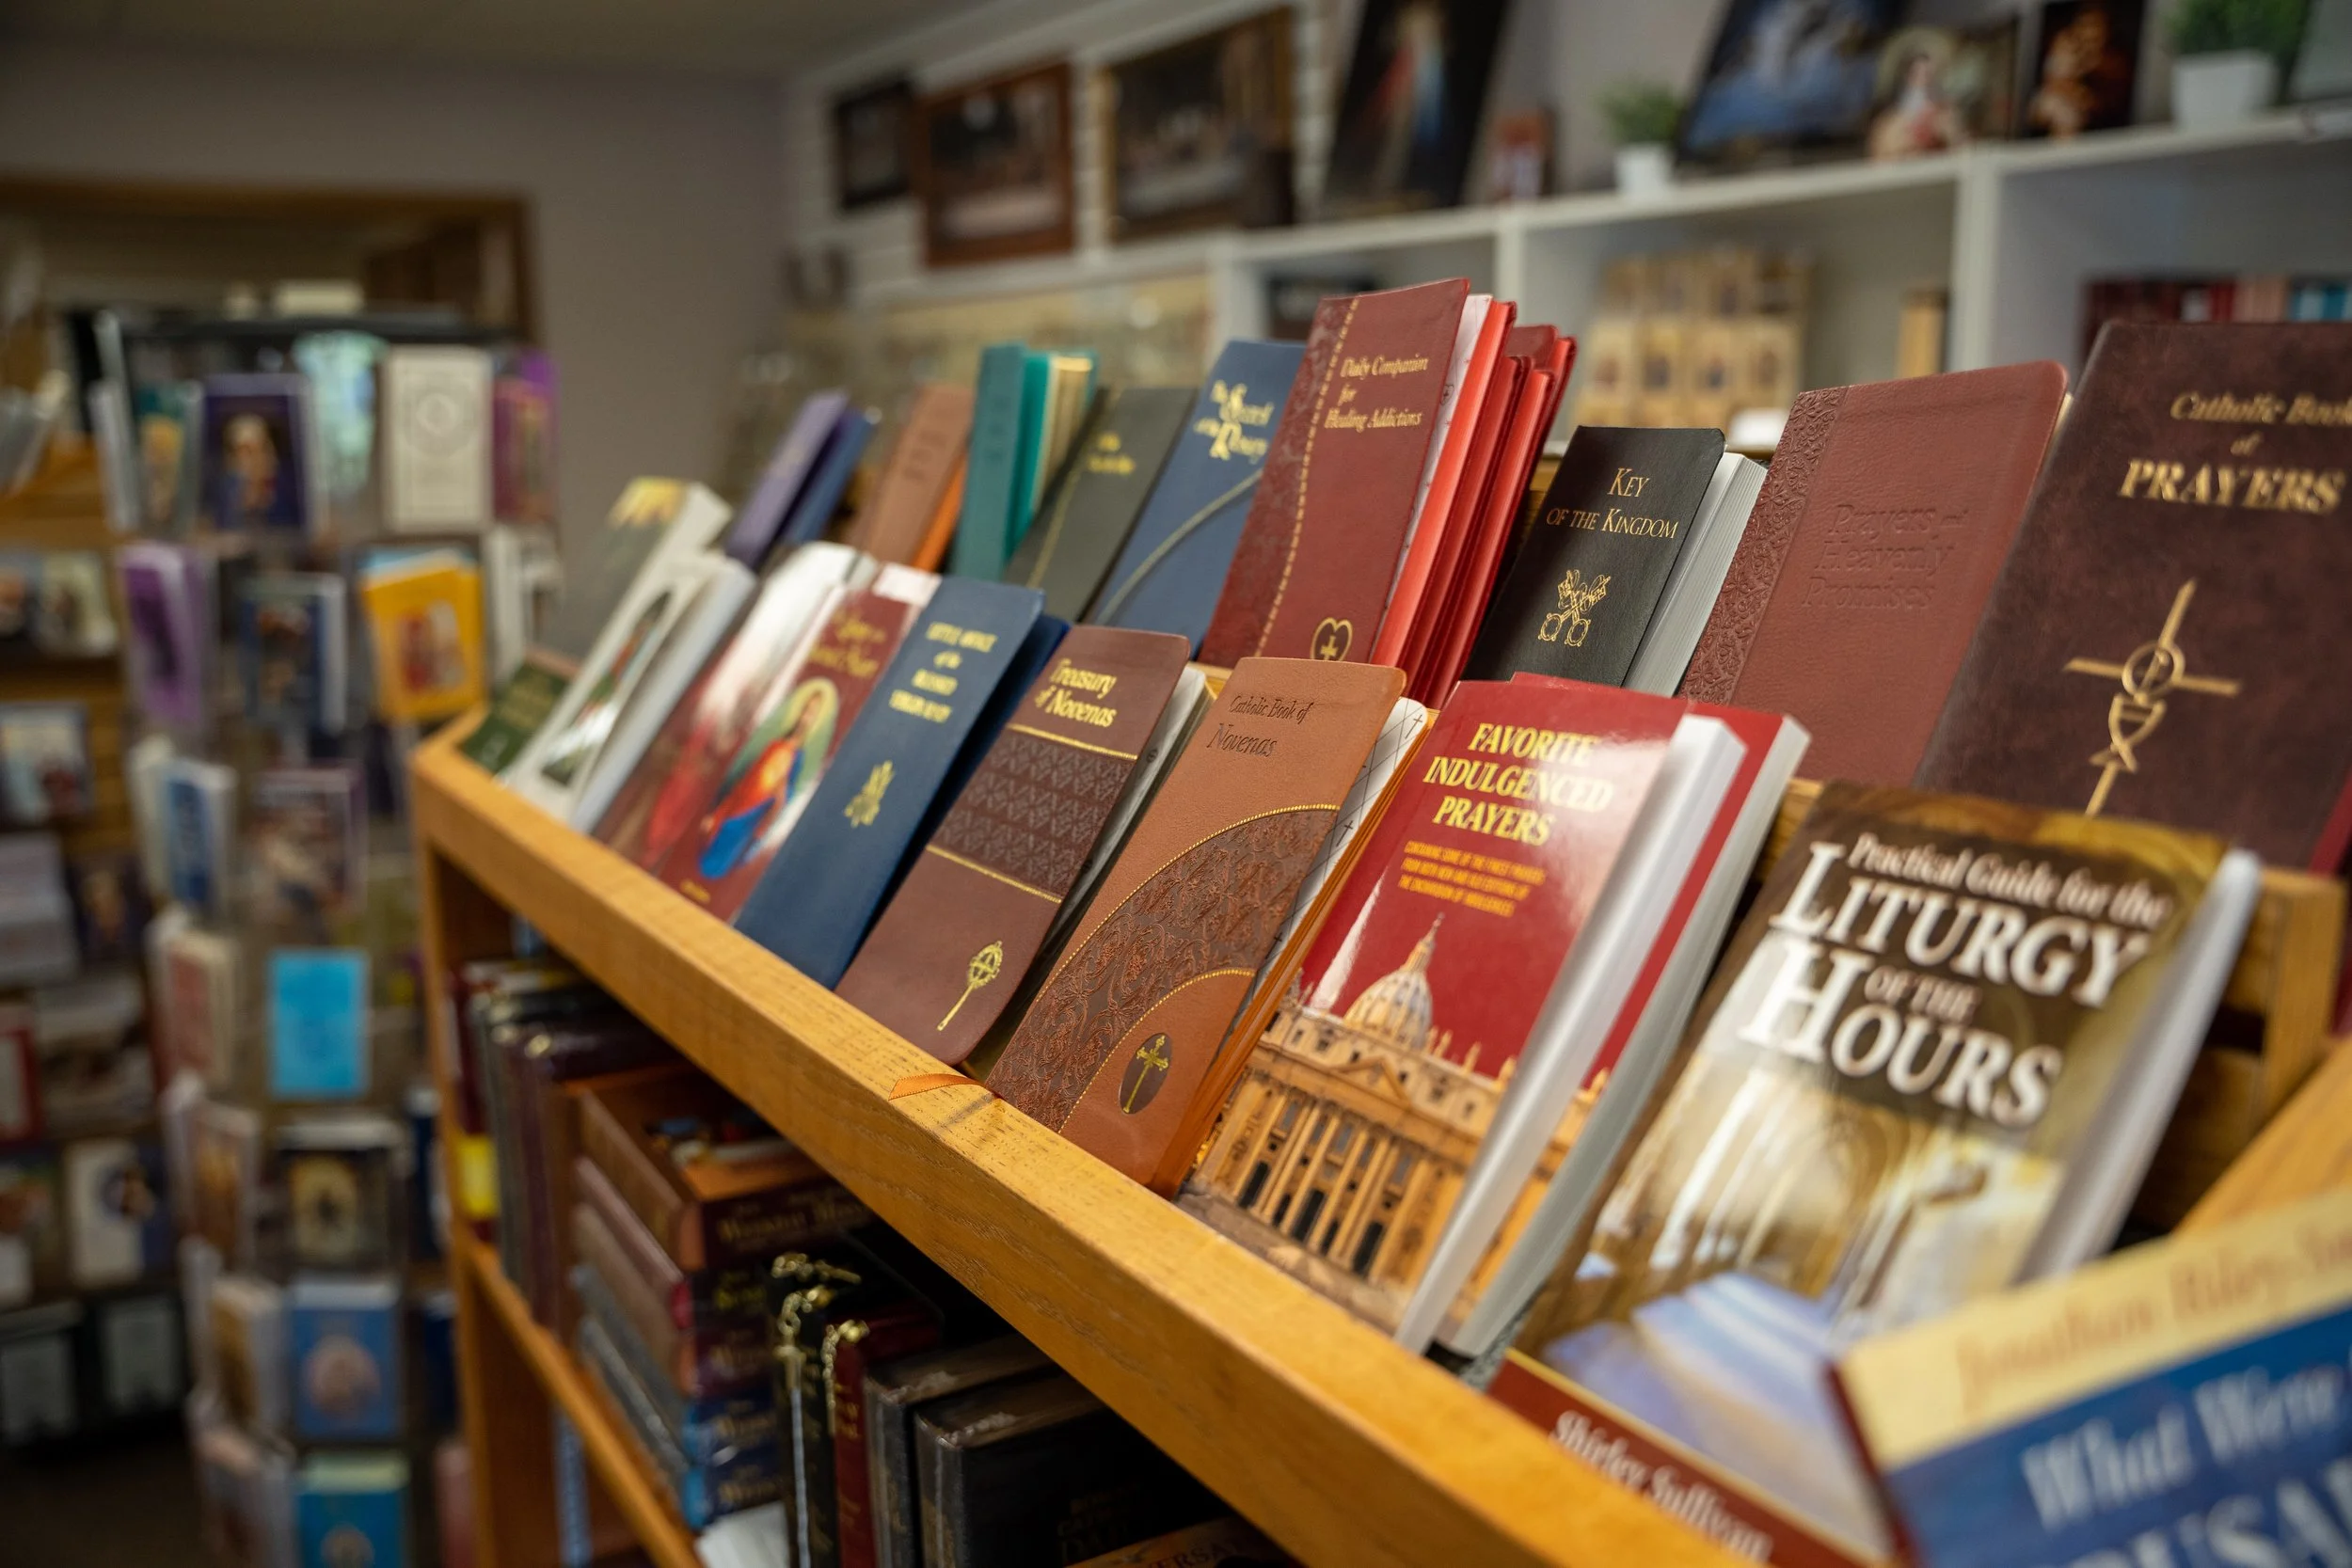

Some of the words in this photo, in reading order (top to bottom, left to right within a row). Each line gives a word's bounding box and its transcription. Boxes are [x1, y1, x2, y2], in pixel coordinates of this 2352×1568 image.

[1340, 356, 1371, 380] Daily
[1372, 353, 1429, 378] Companion
[1337, 383, 1358, 407] for
[2169, 390, 2286, 422] Catholic
[1324, 407, 1368, 433] Healing
[1367, 407, 1422, 428] Addictions
[2118, 458, 2347, 515] PRAYERS
[1601, 508, 1679, 539] KINGDOM
[1827, 504, 1936, 543] Prayers
[1814, 532, 1954, 577] Heavenly
[1801, 576, 1936, 609] Promises
[1049, 658, 1118, 700] Treasury
[1045, 689, 1117, 727] Novenas
[1229, 695, 1269, 717] Catholic
[1267, 698, 1296, 720] Book
[1296, 702, 1314, 725] of
[1206, 722, 1278, 757] Novenas
[1468, 722, 1601, 768] FAVORITE
[1422, 755, 1614, 813] INDULGENCED
[1433, 796, 1556, 847] PRAYERS
[1848, 832, 1973, 889] Practical
[1965, 852, 2061, 908] Guide
[2055, 867, 2113, 919] for
[2108, 879, 2174, 930] the
[1769, 842, 2151, 1008] LITURGY
[1862, 965, 1915, 1006] OF
[1910, 975, 1982, 1024] THE
[1740, 938, 2064, 1128] HOURS
[1549, 1410, 1652, 1493] Shirley
[1646, 1465, 1773, 1566] Sullivan
